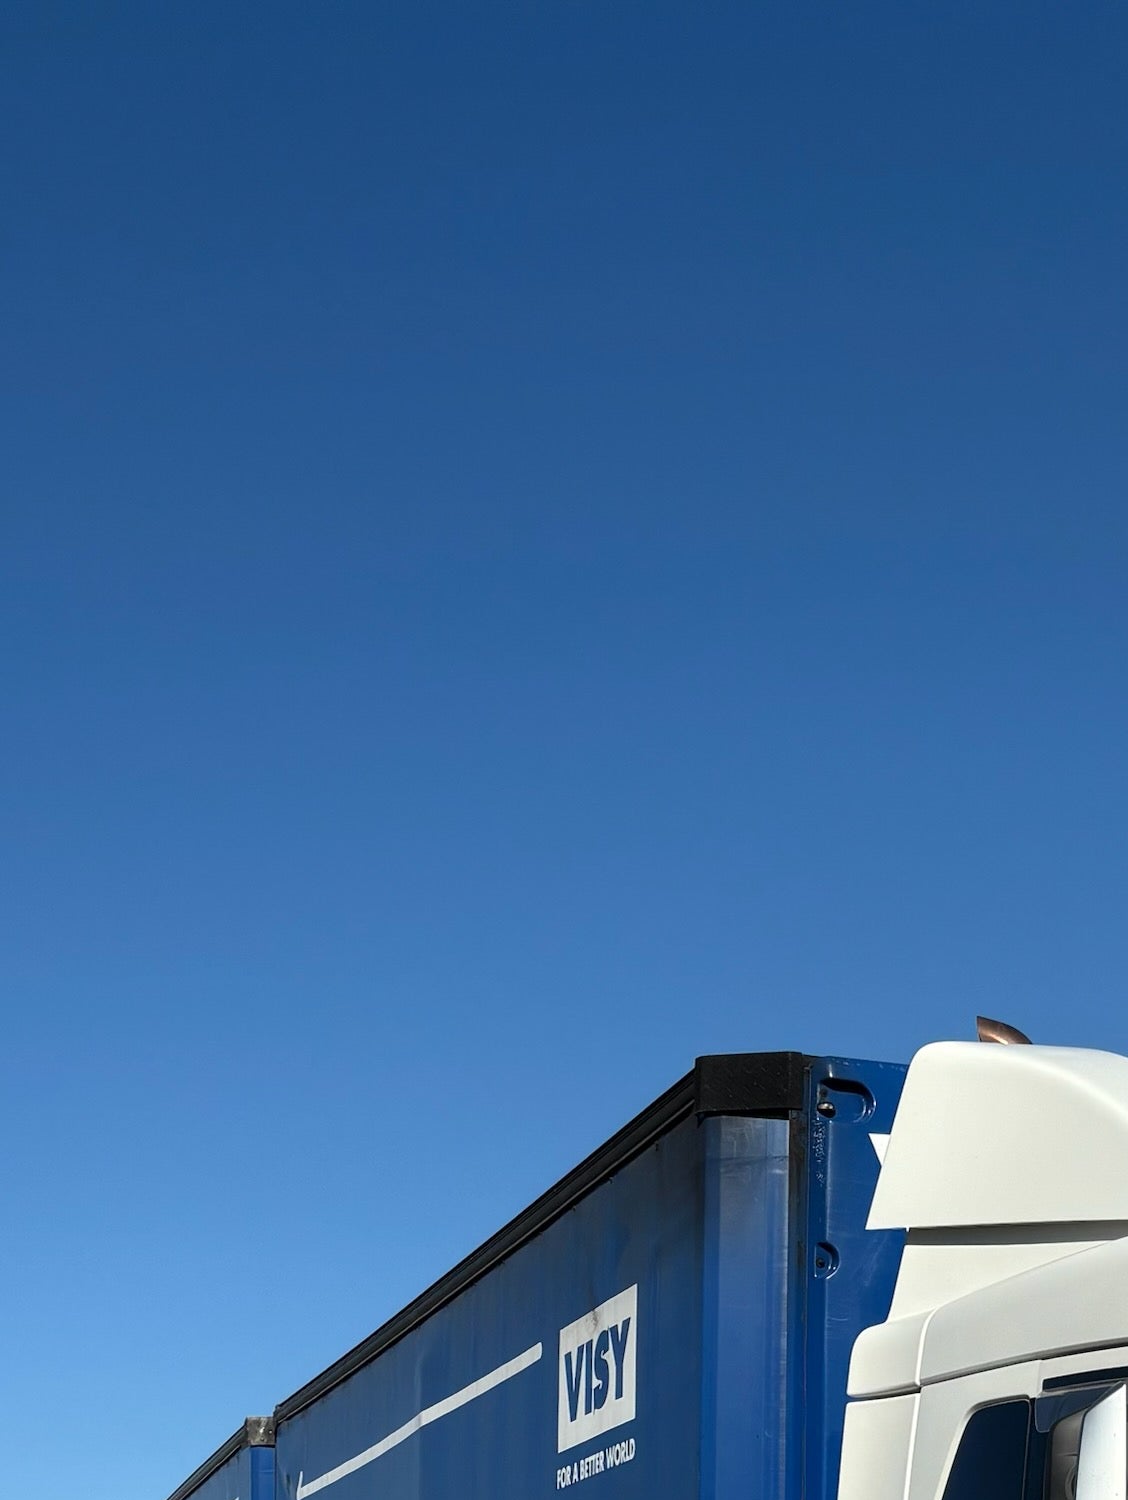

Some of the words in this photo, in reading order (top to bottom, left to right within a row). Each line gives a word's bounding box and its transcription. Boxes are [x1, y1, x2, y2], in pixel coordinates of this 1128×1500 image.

[563, 1316, 631, 1423] VISY
[556, 1464, 572, 1490] FOR
[572, 1462, 579, 1484] A
[579, 1450, 605, 1481] BETTER
[605, 1438, 636, 1470] WORLD
